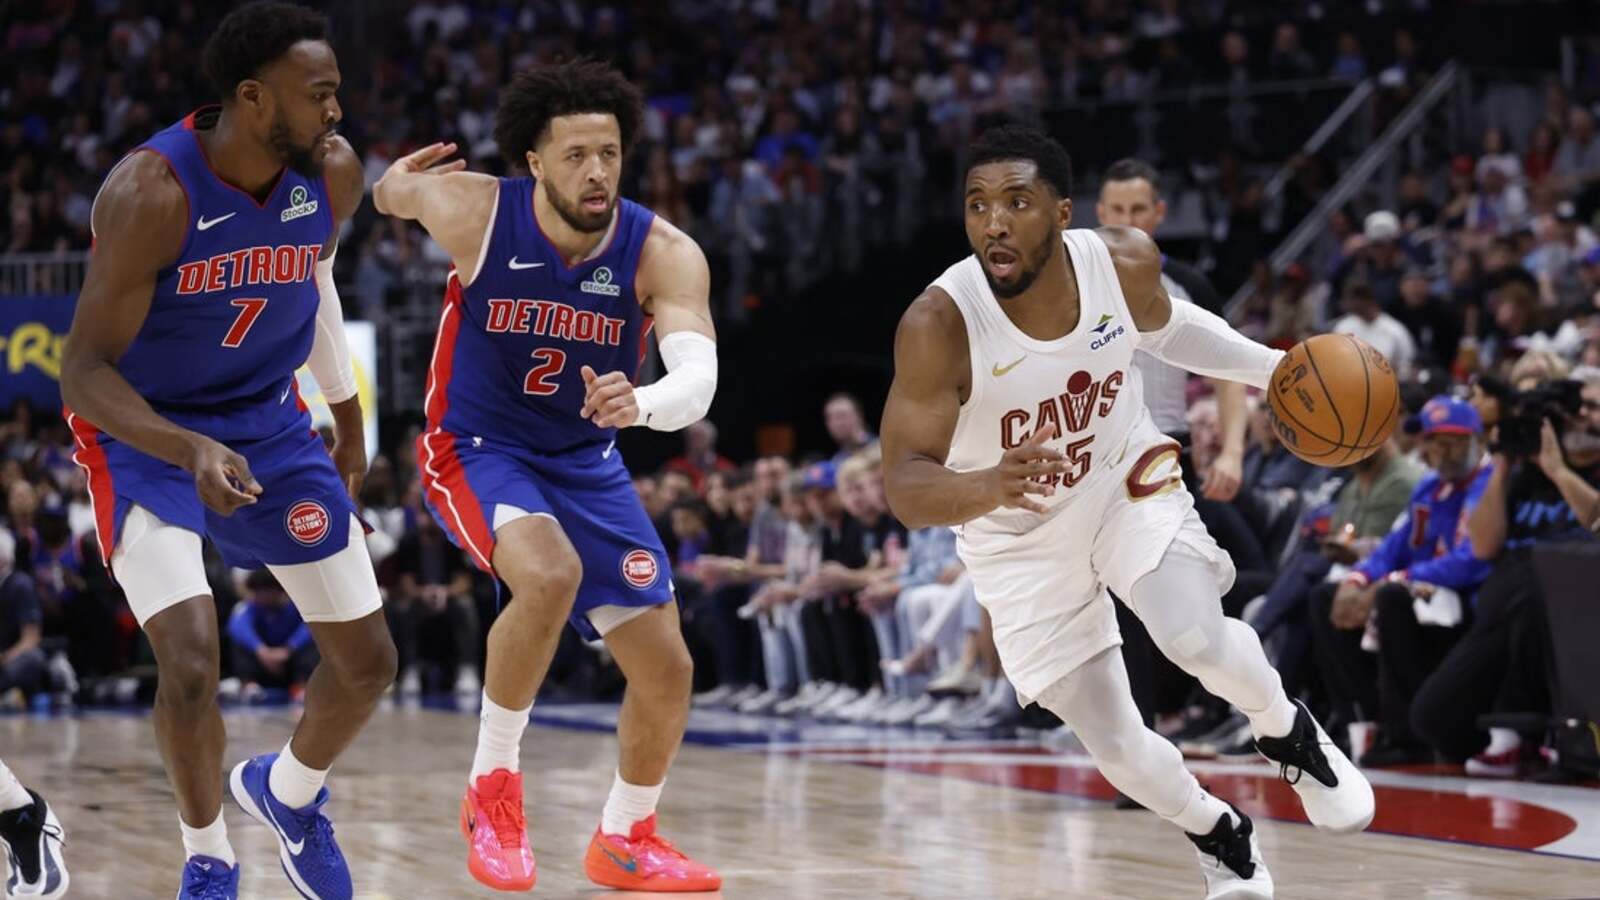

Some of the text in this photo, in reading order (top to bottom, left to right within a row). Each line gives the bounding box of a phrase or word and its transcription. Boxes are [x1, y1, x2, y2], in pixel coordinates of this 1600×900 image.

[176, 244, 322, 295] DETROIT
[221, 298, 268, 348] 7
[486, 299, 625, 346] DETROIT
[1090, 325, 1125, 350] CLIFFS
[523, 347, 567, 395] 2
[1001, 370, 1123, 450] CAVS
